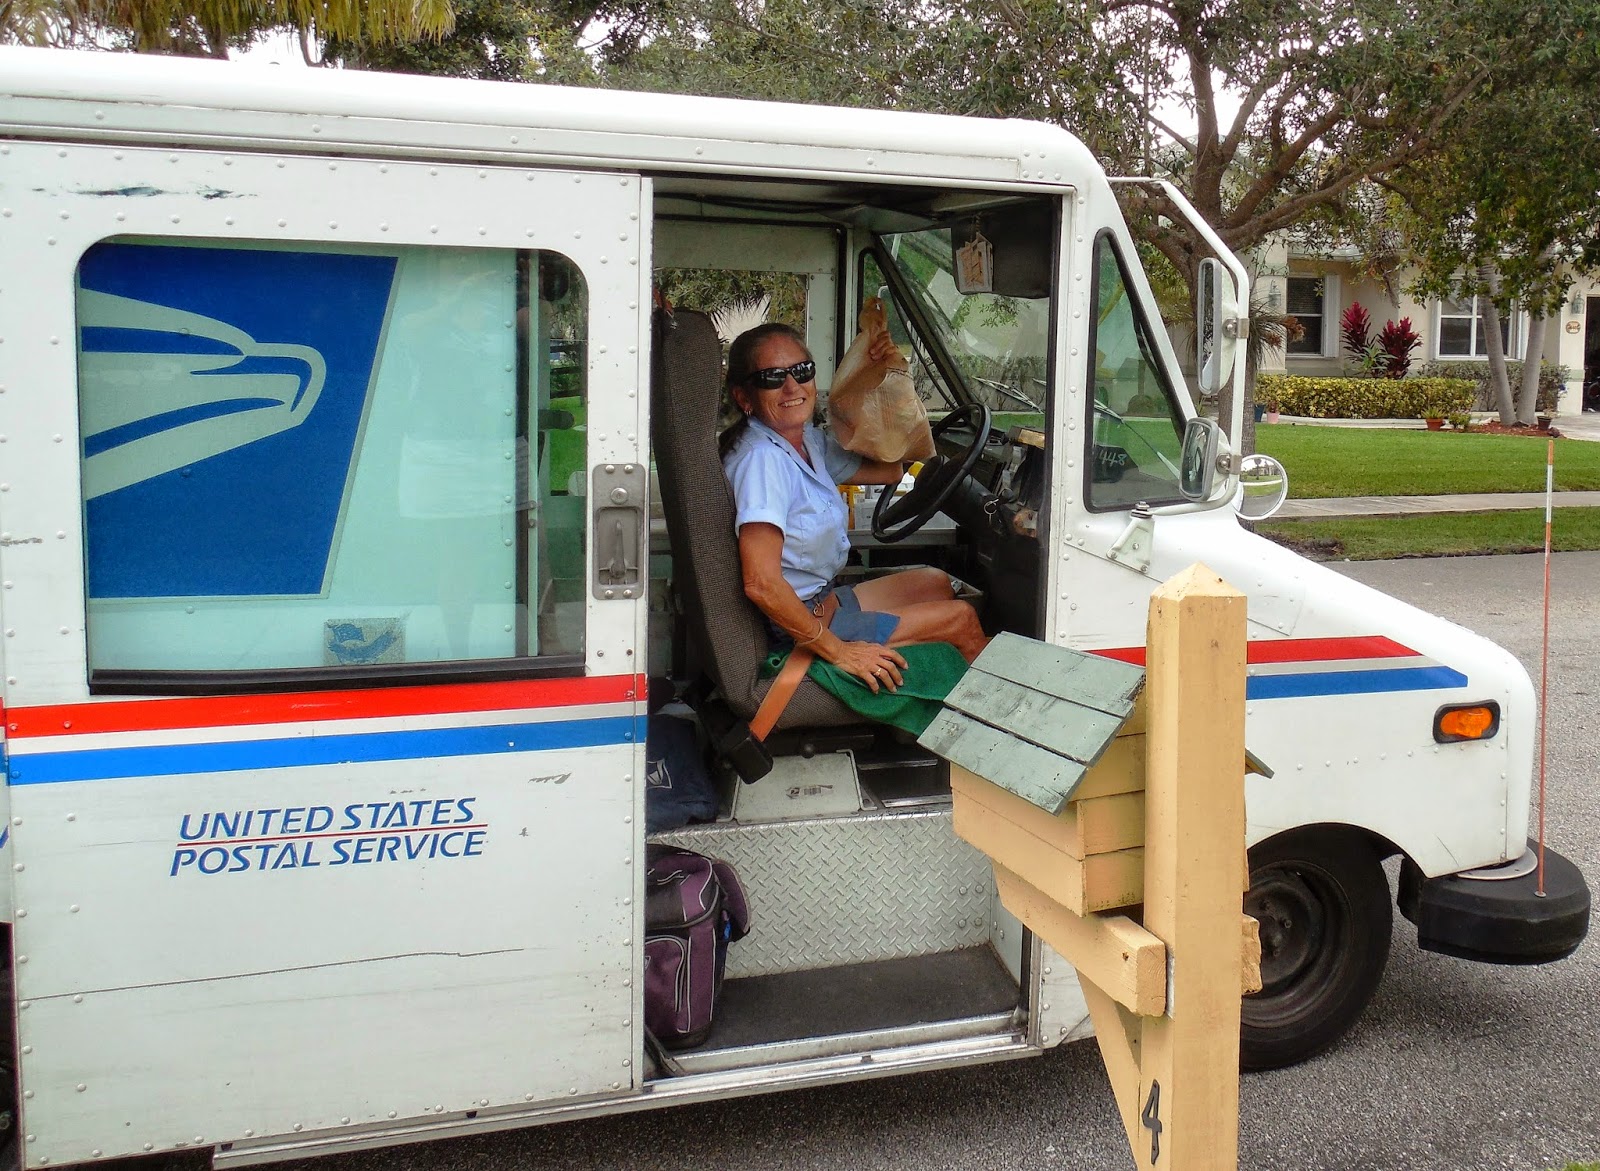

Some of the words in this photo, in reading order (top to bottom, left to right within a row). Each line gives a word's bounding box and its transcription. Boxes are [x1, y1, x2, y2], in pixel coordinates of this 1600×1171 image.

[180, 805, 333, 841] UNITED
[341, 797, 477, 830] STATES
[169, 841, 321, 877] POSTAL
[328, 830, 488, 866] SERVICE
[1141, 1078, 1163, 1166] 4
